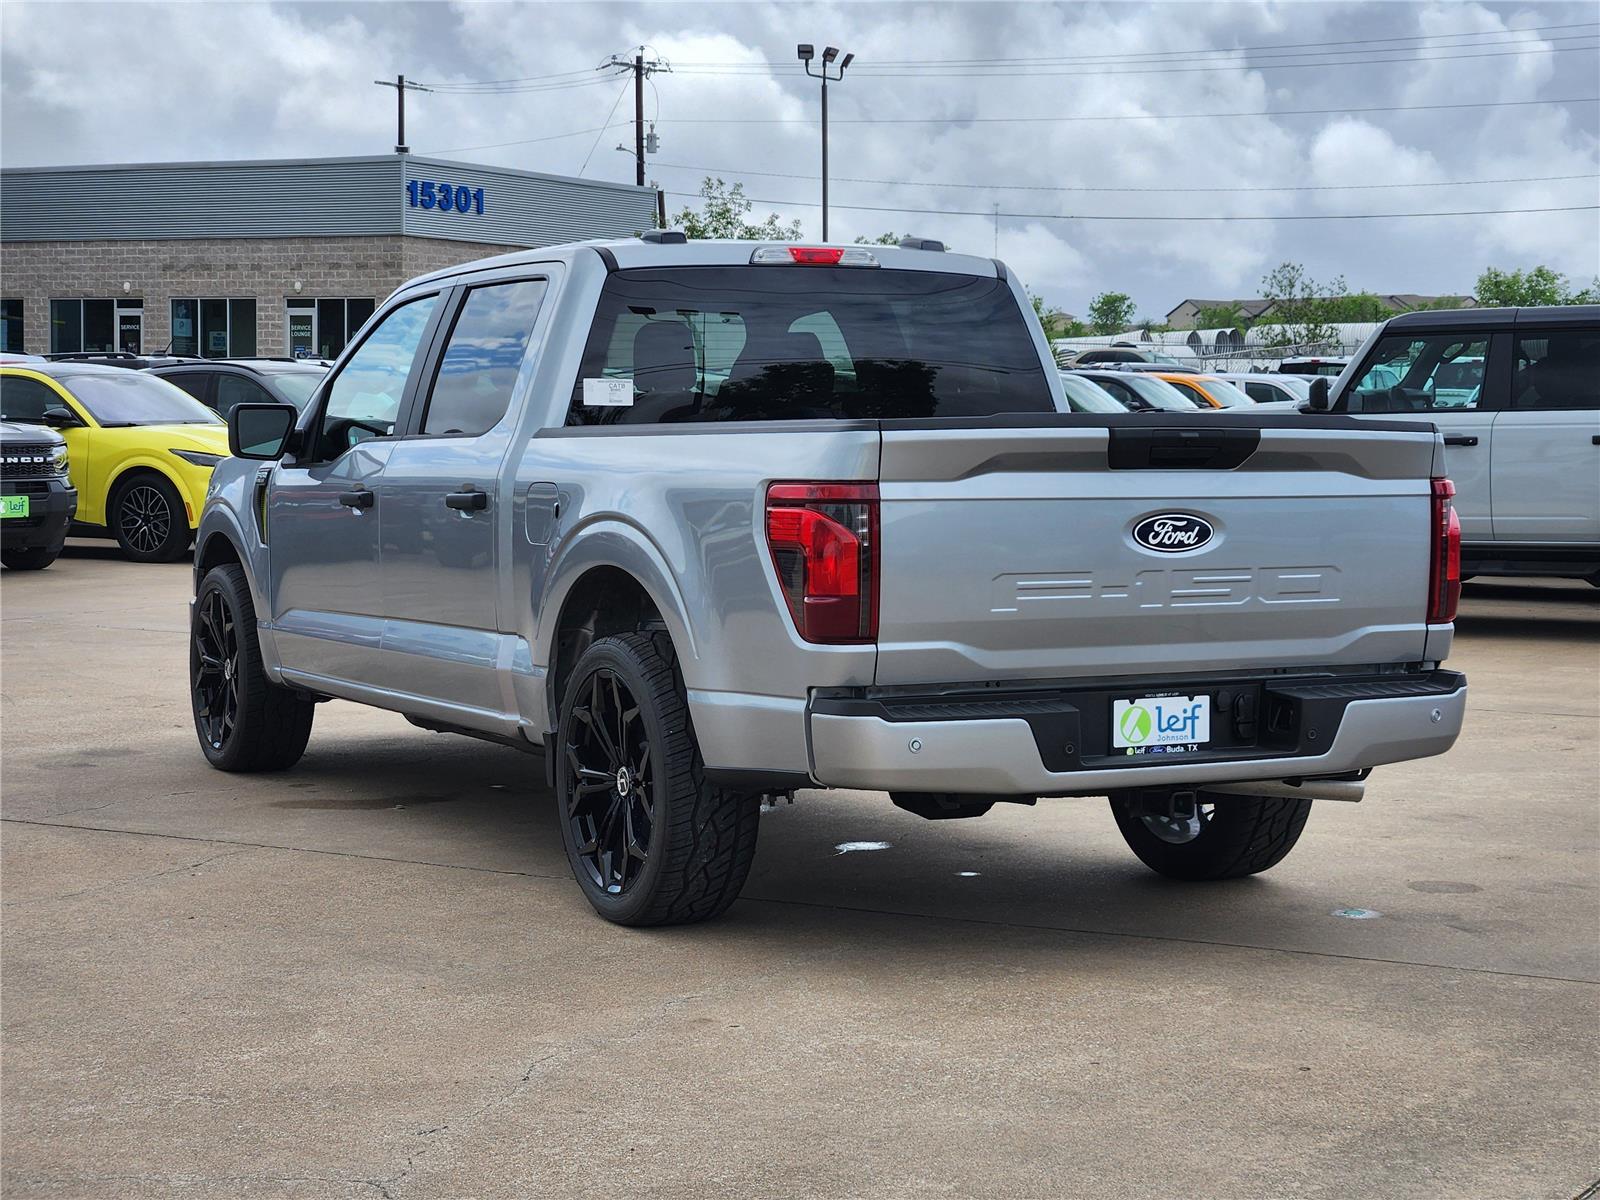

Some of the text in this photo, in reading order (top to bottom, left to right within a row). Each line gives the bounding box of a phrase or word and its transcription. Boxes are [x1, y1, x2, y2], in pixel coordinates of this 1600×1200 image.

[405, 179, 485, 215] 15301
[1148, 519, 1201, 545] Ford
[990, 564, 1342, 613] F-150
[1155, 704, 1202, 740] leif
[1157, 733, 1190, 742] Johnson
[1187, 743, 1199, 752] TX
